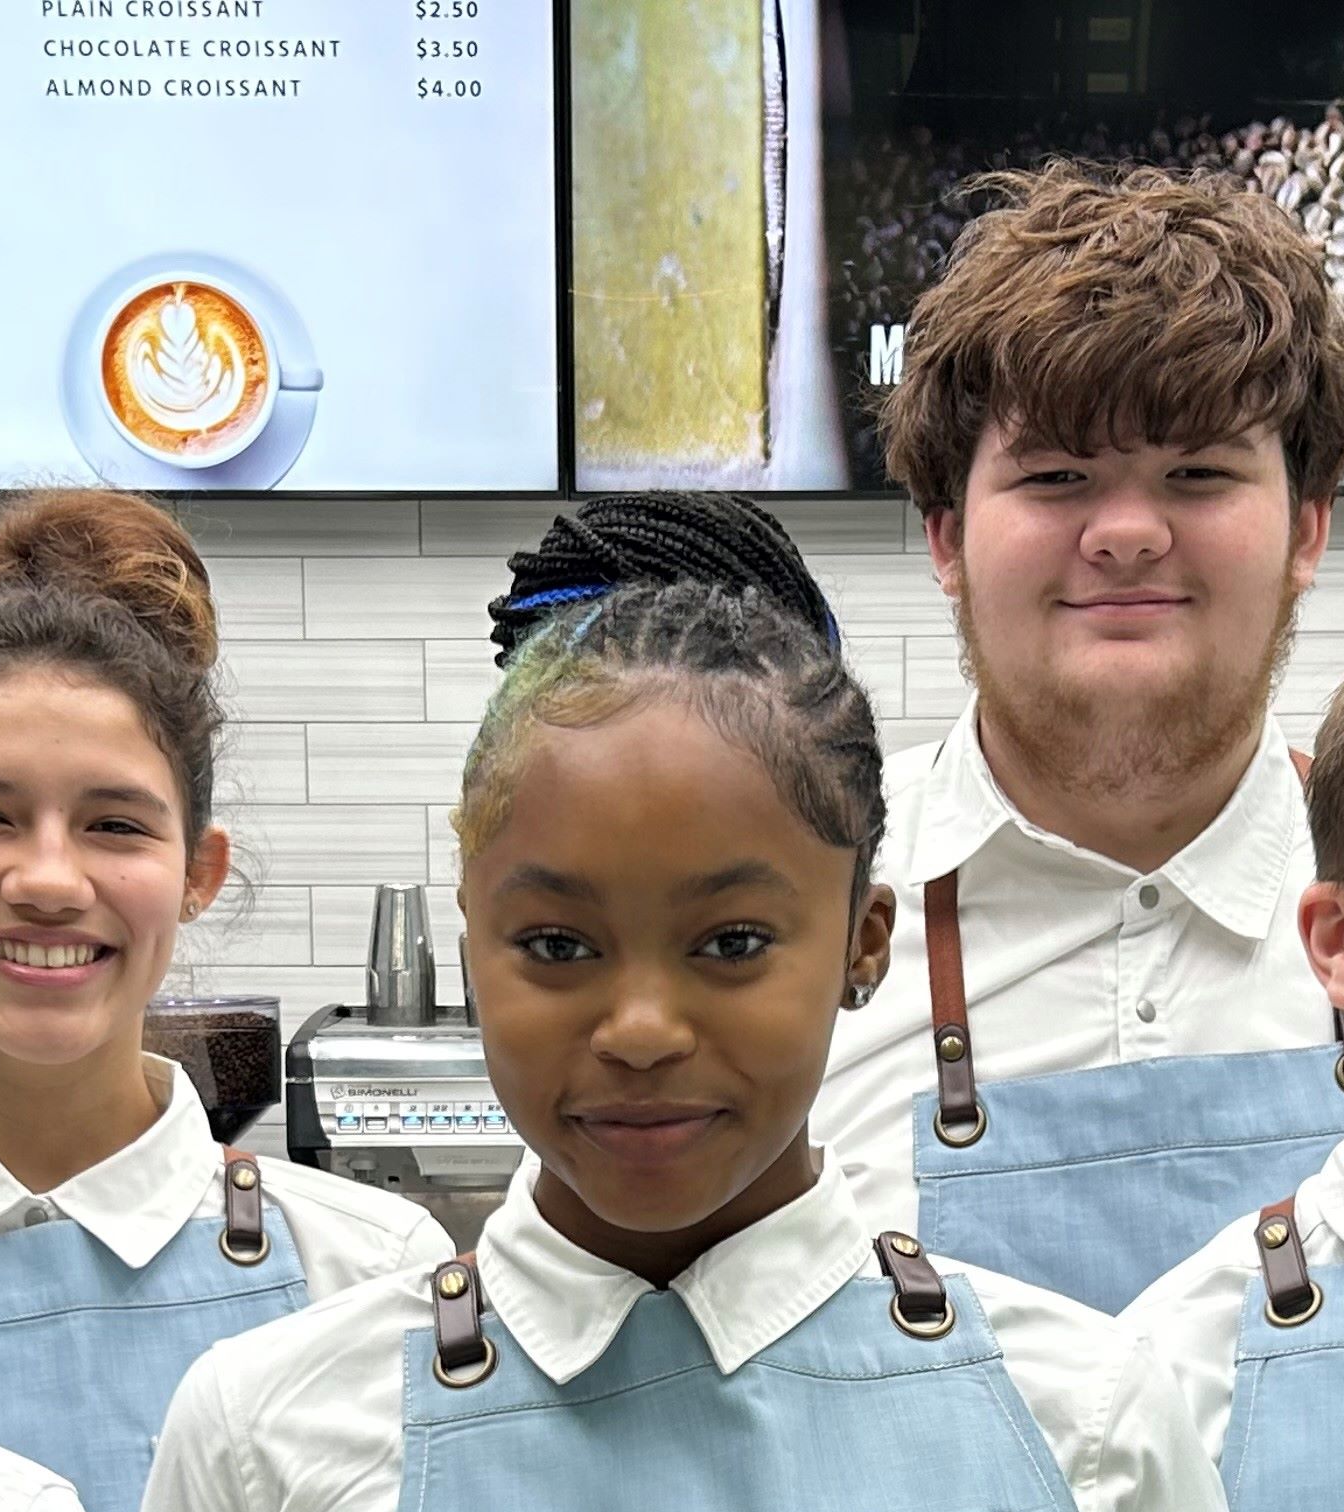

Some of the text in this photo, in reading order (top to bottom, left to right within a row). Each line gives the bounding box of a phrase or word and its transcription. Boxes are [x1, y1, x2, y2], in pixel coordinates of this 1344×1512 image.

[42, 0, 263, 17] PLAIN CROISSANT
[416, 0, 477, 20] $2.50
[44, 40, 340, 57] CHOCOLATE CROISSANT
[417, 38, 477, 59] $3.50
[46, 79, 300, 96] ALMOND CROISSANT
[418, 78, 481, 99] $4.00
[348, 1088, 418, 1097] SIMONELLI
